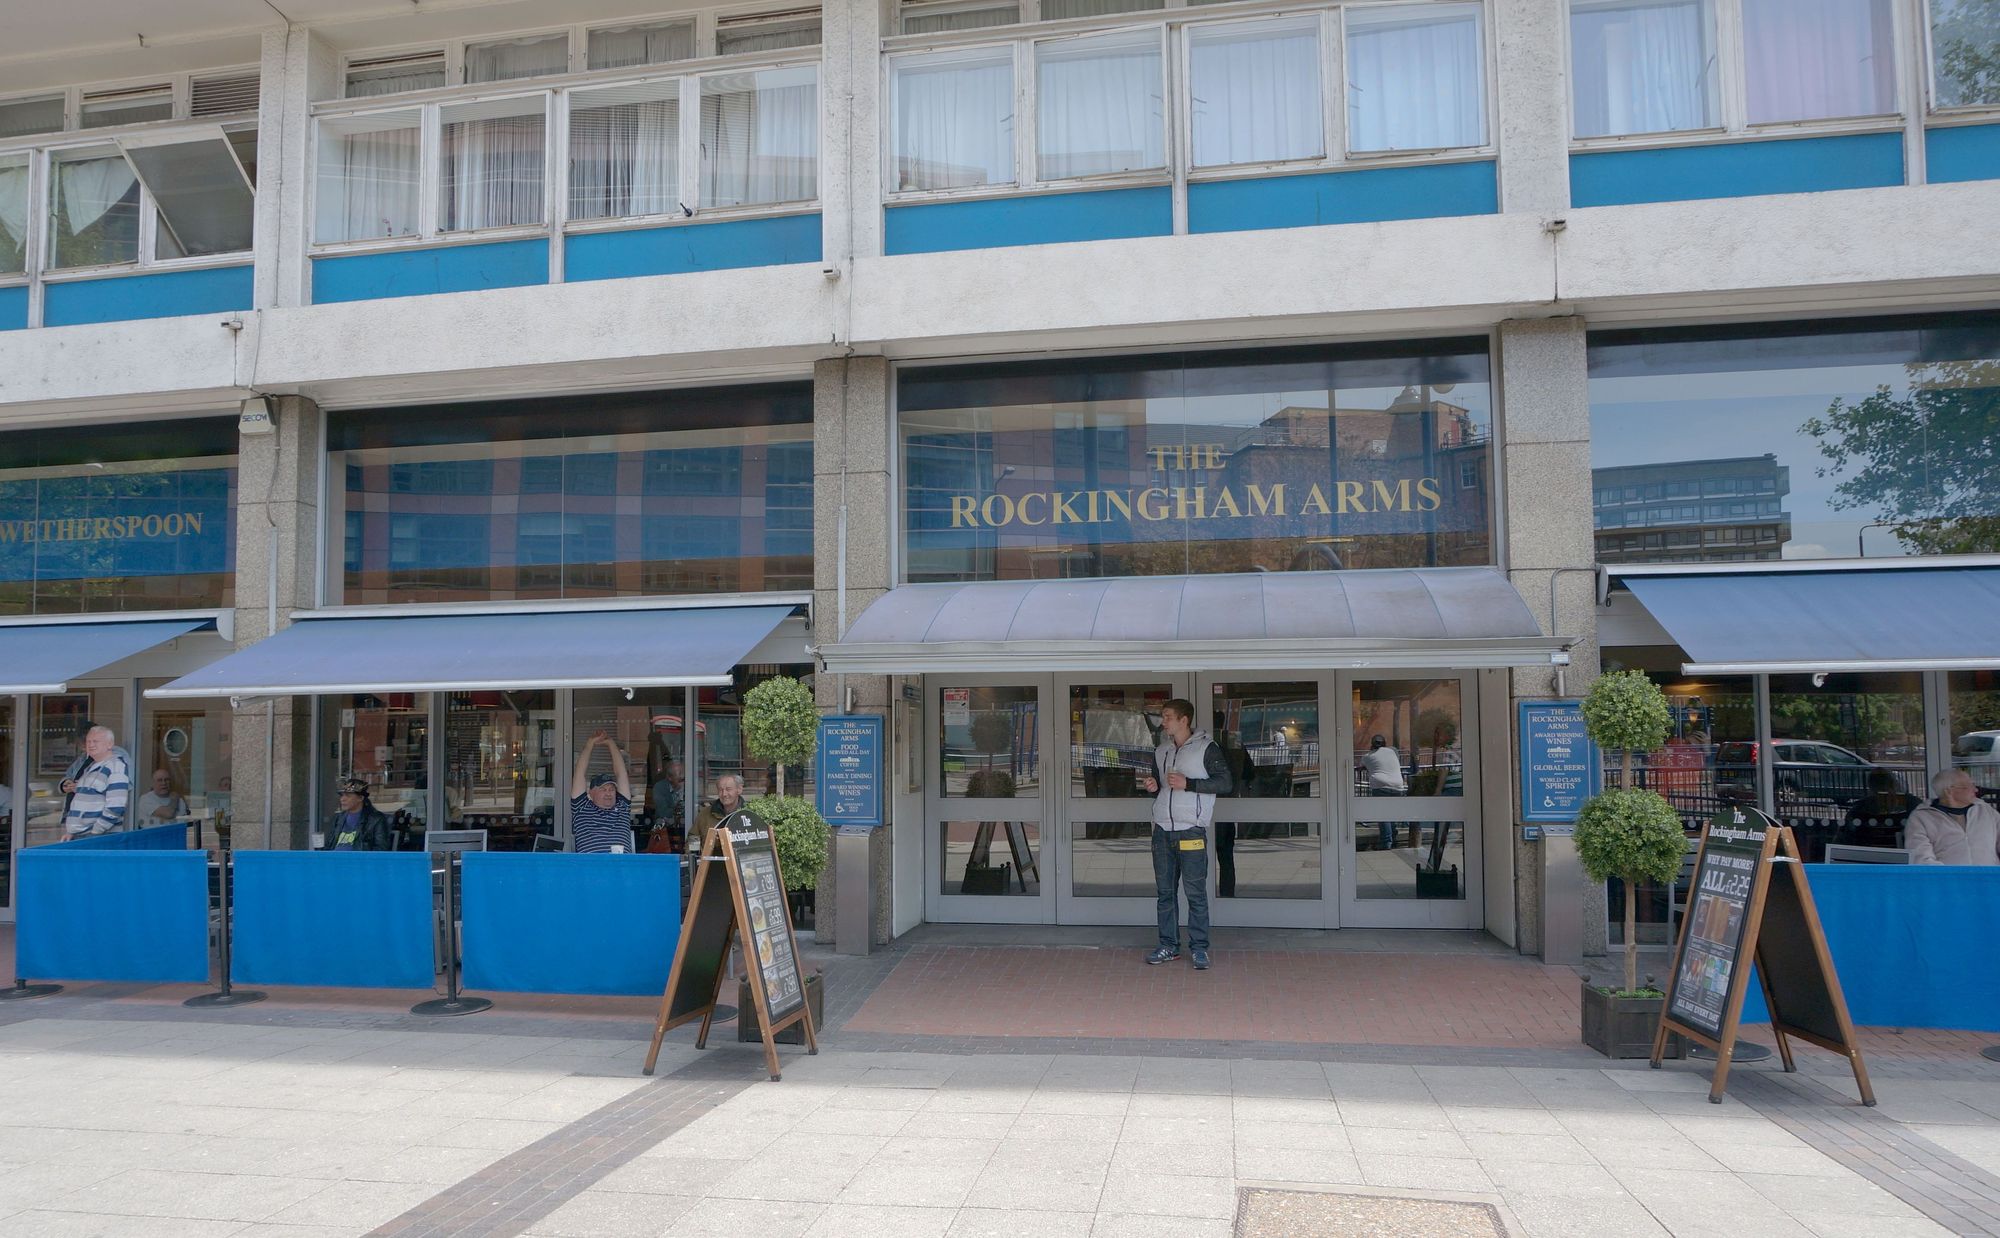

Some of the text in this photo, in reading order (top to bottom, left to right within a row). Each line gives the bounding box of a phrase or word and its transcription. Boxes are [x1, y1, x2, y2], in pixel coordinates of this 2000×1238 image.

[1150, 443, 1226, 471] THE
[950, 477, 1441, 529] ROCKINGHAM ARMS
[0, 512, 203, 543] WETHERSPOON
[1532, 715, 1584, 723] ROCKINGHAM
[741, 815, 751, 826] The
[1733, 811, 1746, 823] The
[1709, 825, 1767, 843] Rockingham Arms
[1707, 854, 1754, 871] WHY PAY MORE?
[1701, 870, 1726, 893] ALL
